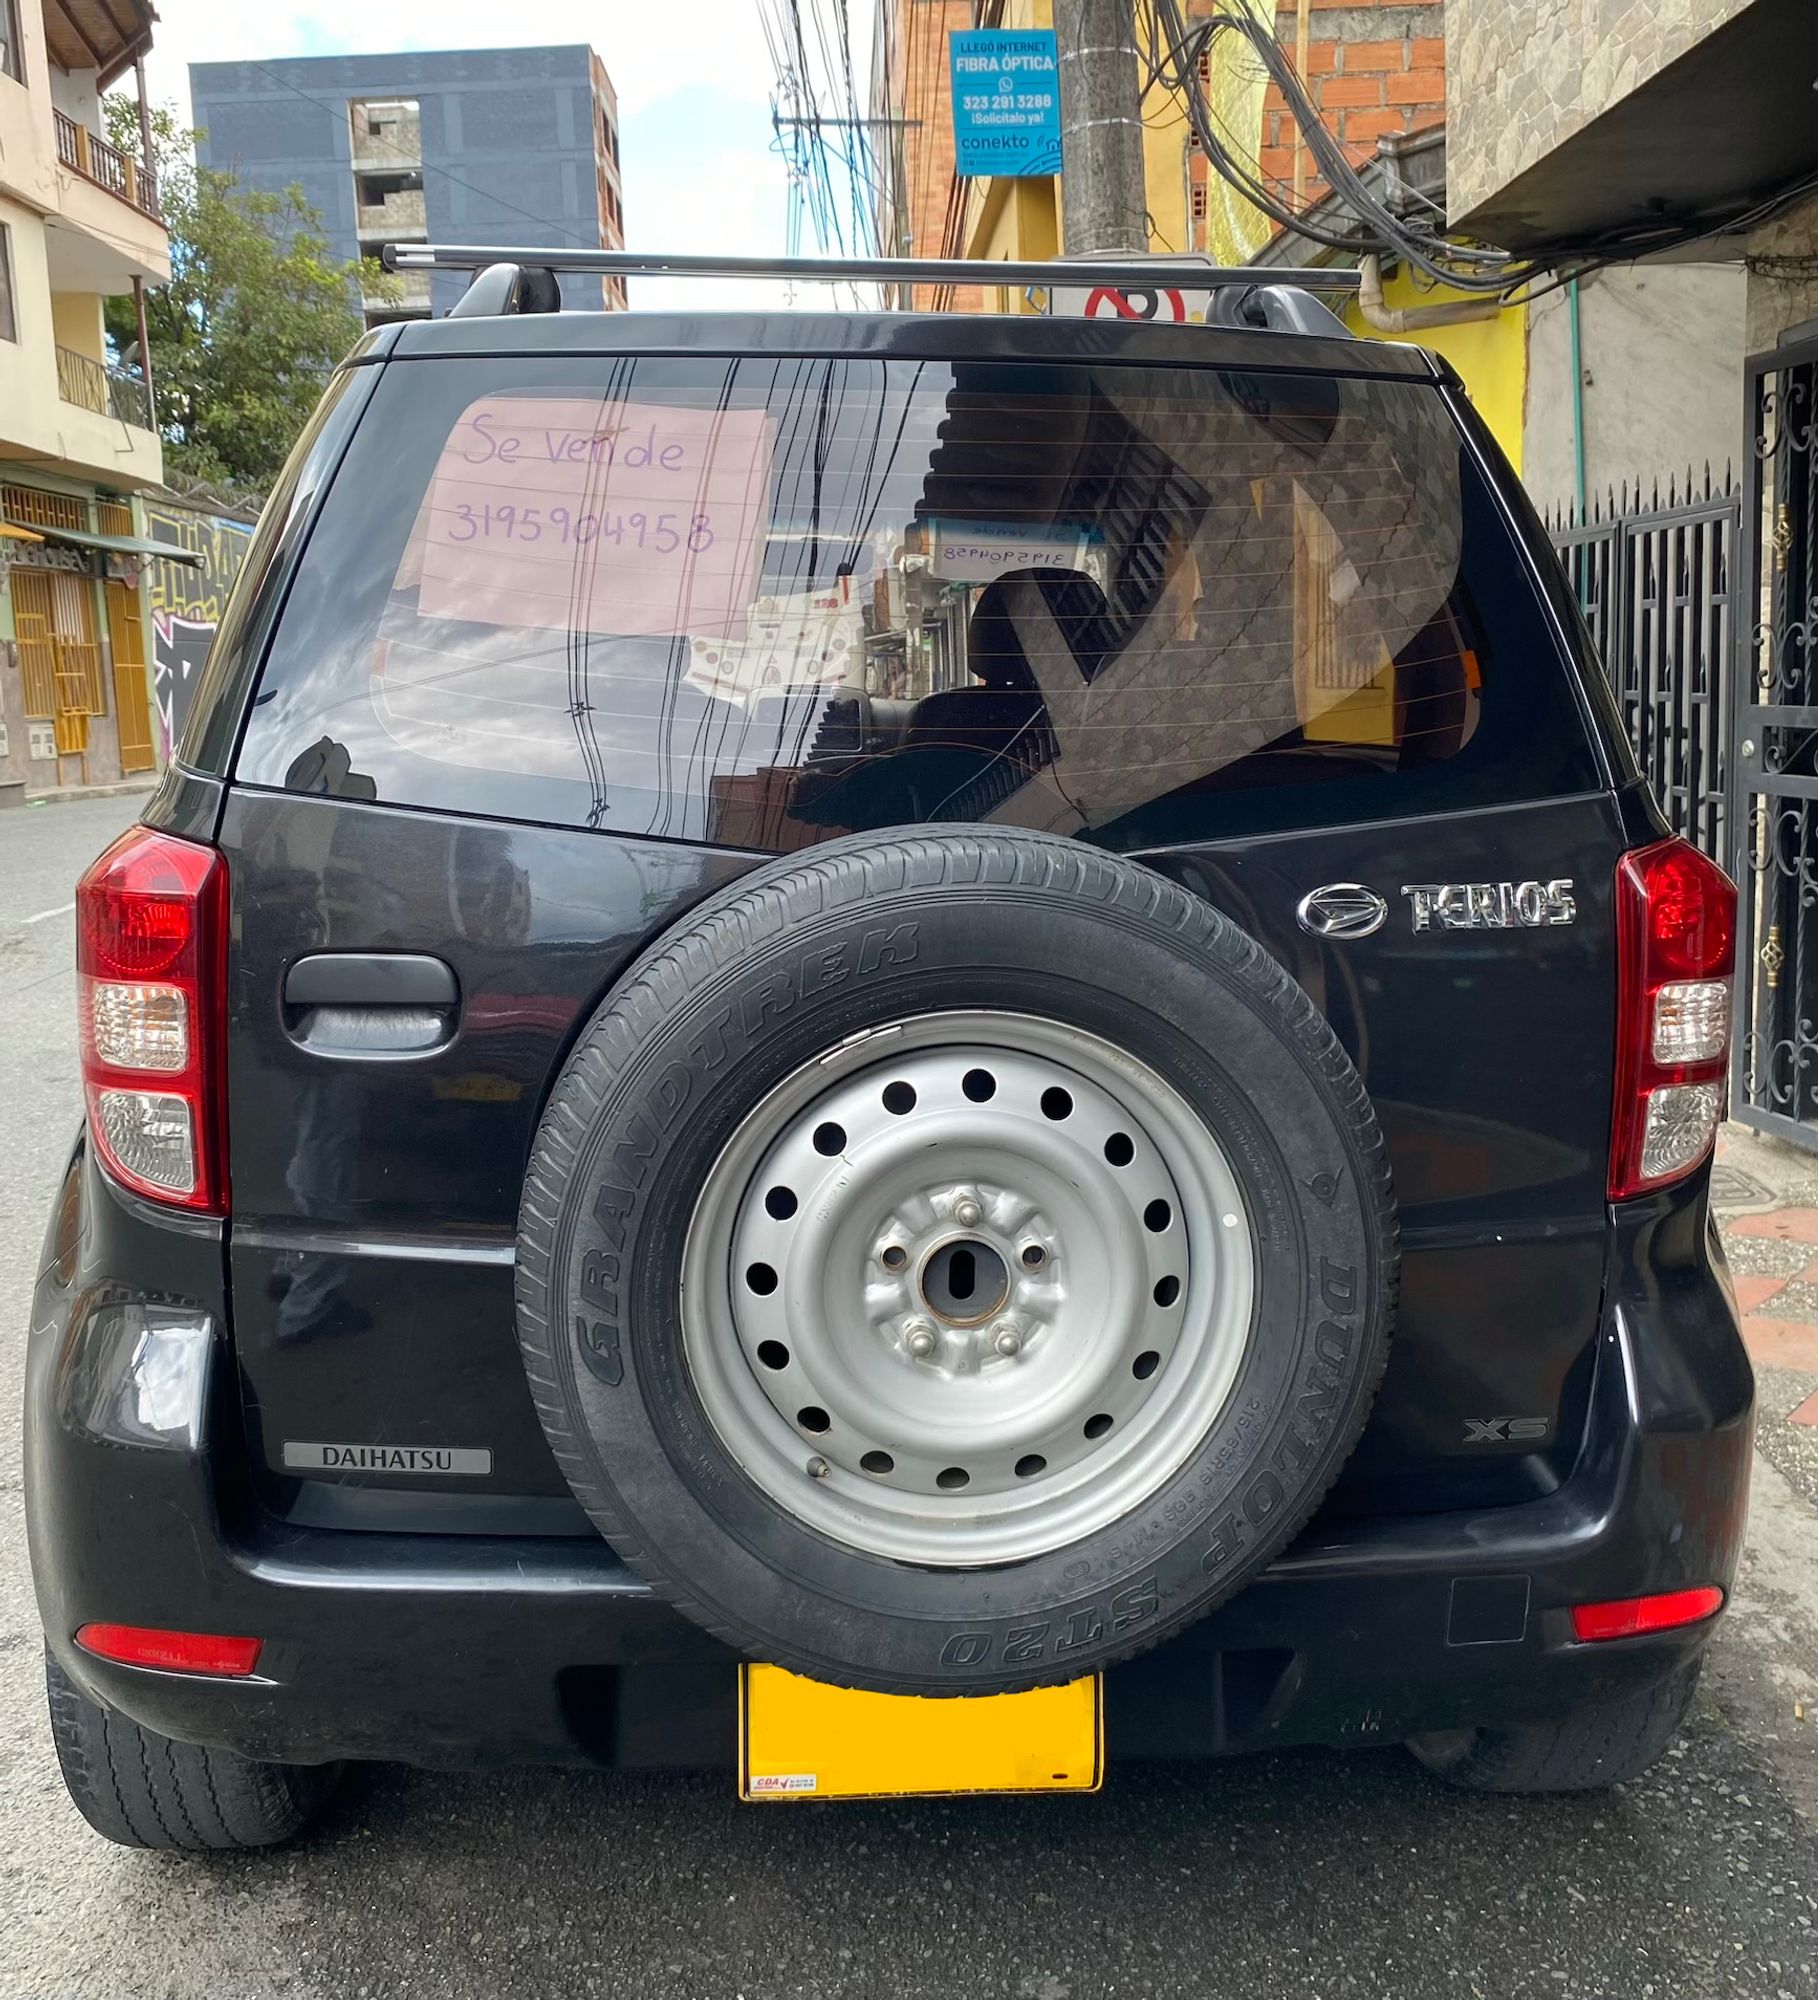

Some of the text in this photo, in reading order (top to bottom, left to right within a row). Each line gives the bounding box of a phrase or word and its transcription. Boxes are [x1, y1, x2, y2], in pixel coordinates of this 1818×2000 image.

[956, 53, 1054, 72] FIBRA ÓPTICA
[997, 42, 1047, 52] INTERNET
[963, 96, 988, 109] 323
[1017, 94, 1052, 108] 3288
[961, 134, 1030, 149] conekto
[463, 413, 520, 464] Se
[448, 504, 715, 554] 3195904958
[1401, 879, 1577, 935] TERIOS
[580, 922, 921, 1386] GRANDTREK
[1201, 1257, 1359, 1575] DUNLOP
[1462, 1416, 1549, 1442] XS
[322, 1447, 452, 1470] DAIHATSU
[940, 1576, 1159, 1667] ST20
